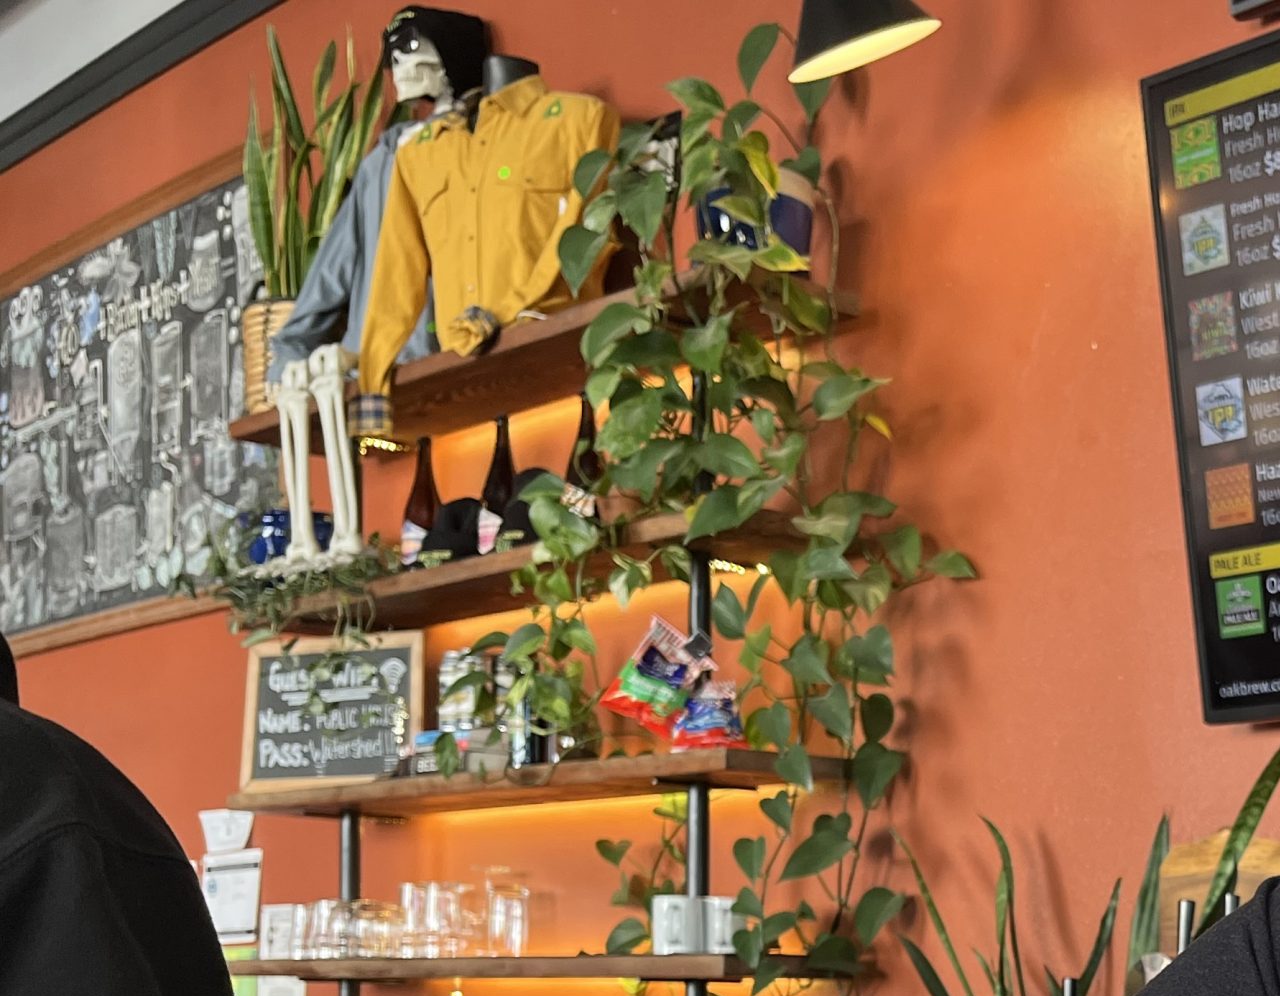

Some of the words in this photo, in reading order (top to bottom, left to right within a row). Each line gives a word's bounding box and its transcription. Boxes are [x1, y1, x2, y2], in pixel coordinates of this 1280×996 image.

[1222, 111, 1255, 134] Hop
[1224, 132, 1264, 158] Fresh
[1229, 161, 1261, 183] 16oz
[1230, 196, 1263, 217] Fresh
[1232, 214, 1275, 241] Fresh
[1236, 243, 1270, 267] 16oz
[1239, 283, 1272, 310] Kiwi
[1241, 311, 1280, 335] West
[1246, 339, 1280, 360] 16oz
[1213, 556, 1239, 571] PALE
[1240, 552, 1263, 567] ALE
